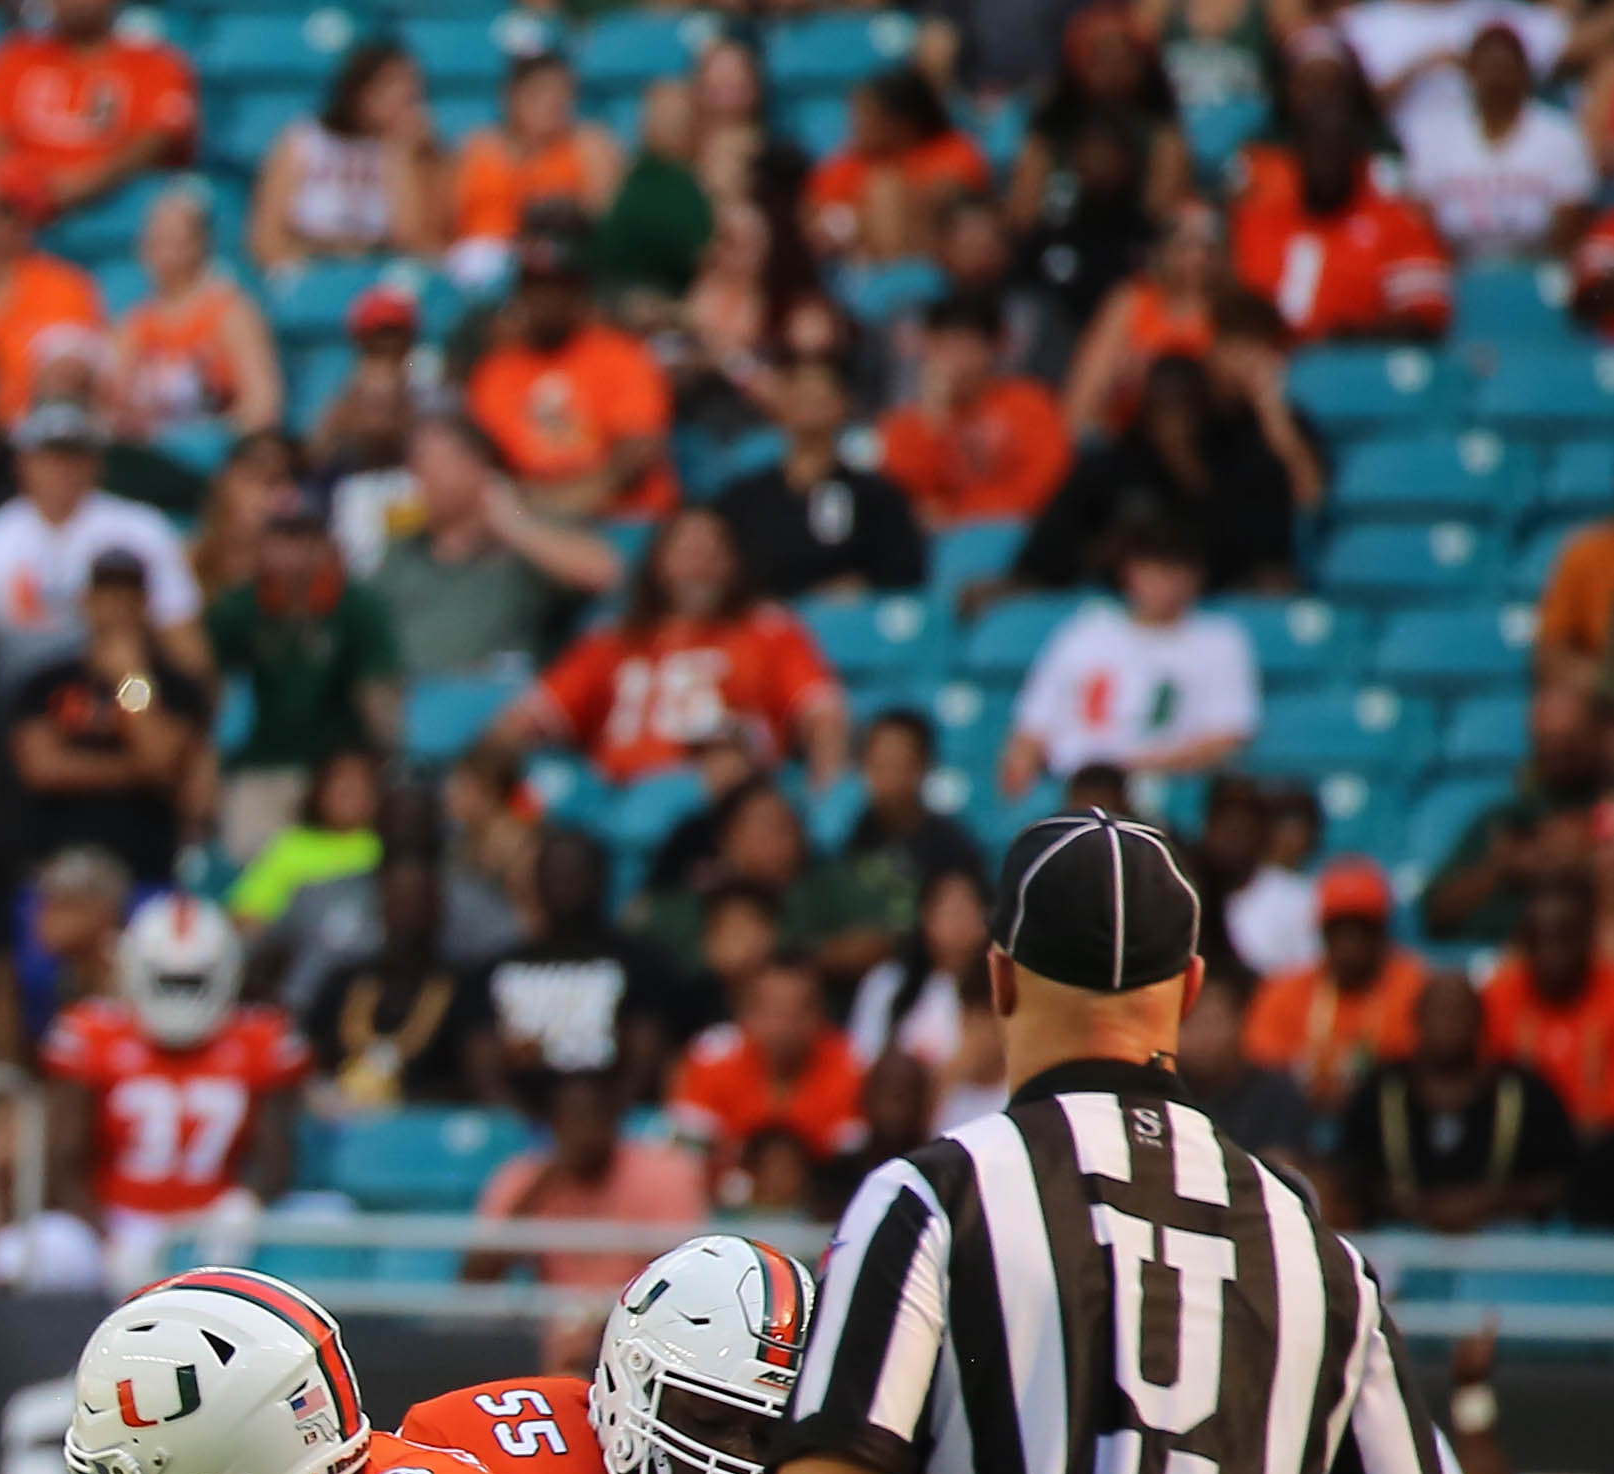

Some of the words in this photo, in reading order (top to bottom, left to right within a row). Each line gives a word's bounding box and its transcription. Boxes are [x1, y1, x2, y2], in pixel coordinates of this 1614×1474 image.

[108, 1073, 250, 1186] 37
[1090, 1203, 1238, 1435] U
[116, 1364, 202, 1428] U
[474, 1389, 569, 1458] 55
